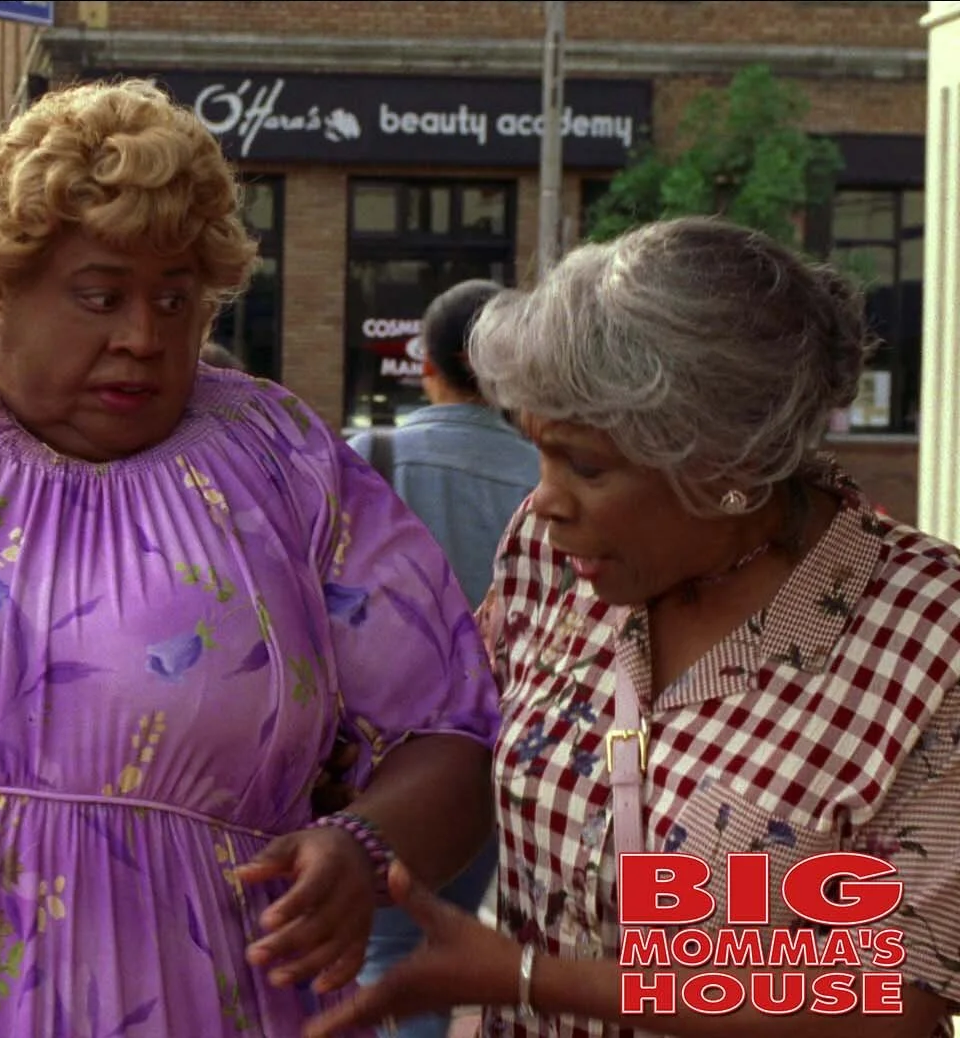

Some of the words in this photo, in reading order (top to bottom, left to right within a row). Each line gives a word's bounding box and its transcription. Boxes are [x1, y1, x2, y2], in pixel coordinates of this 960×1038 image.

[194, 78, 322, 158] O'Hara's
[379, 103, 488, 146] beauty
[495, 106, 633, 148] academy
[362, 318, 422, 338] COSME
